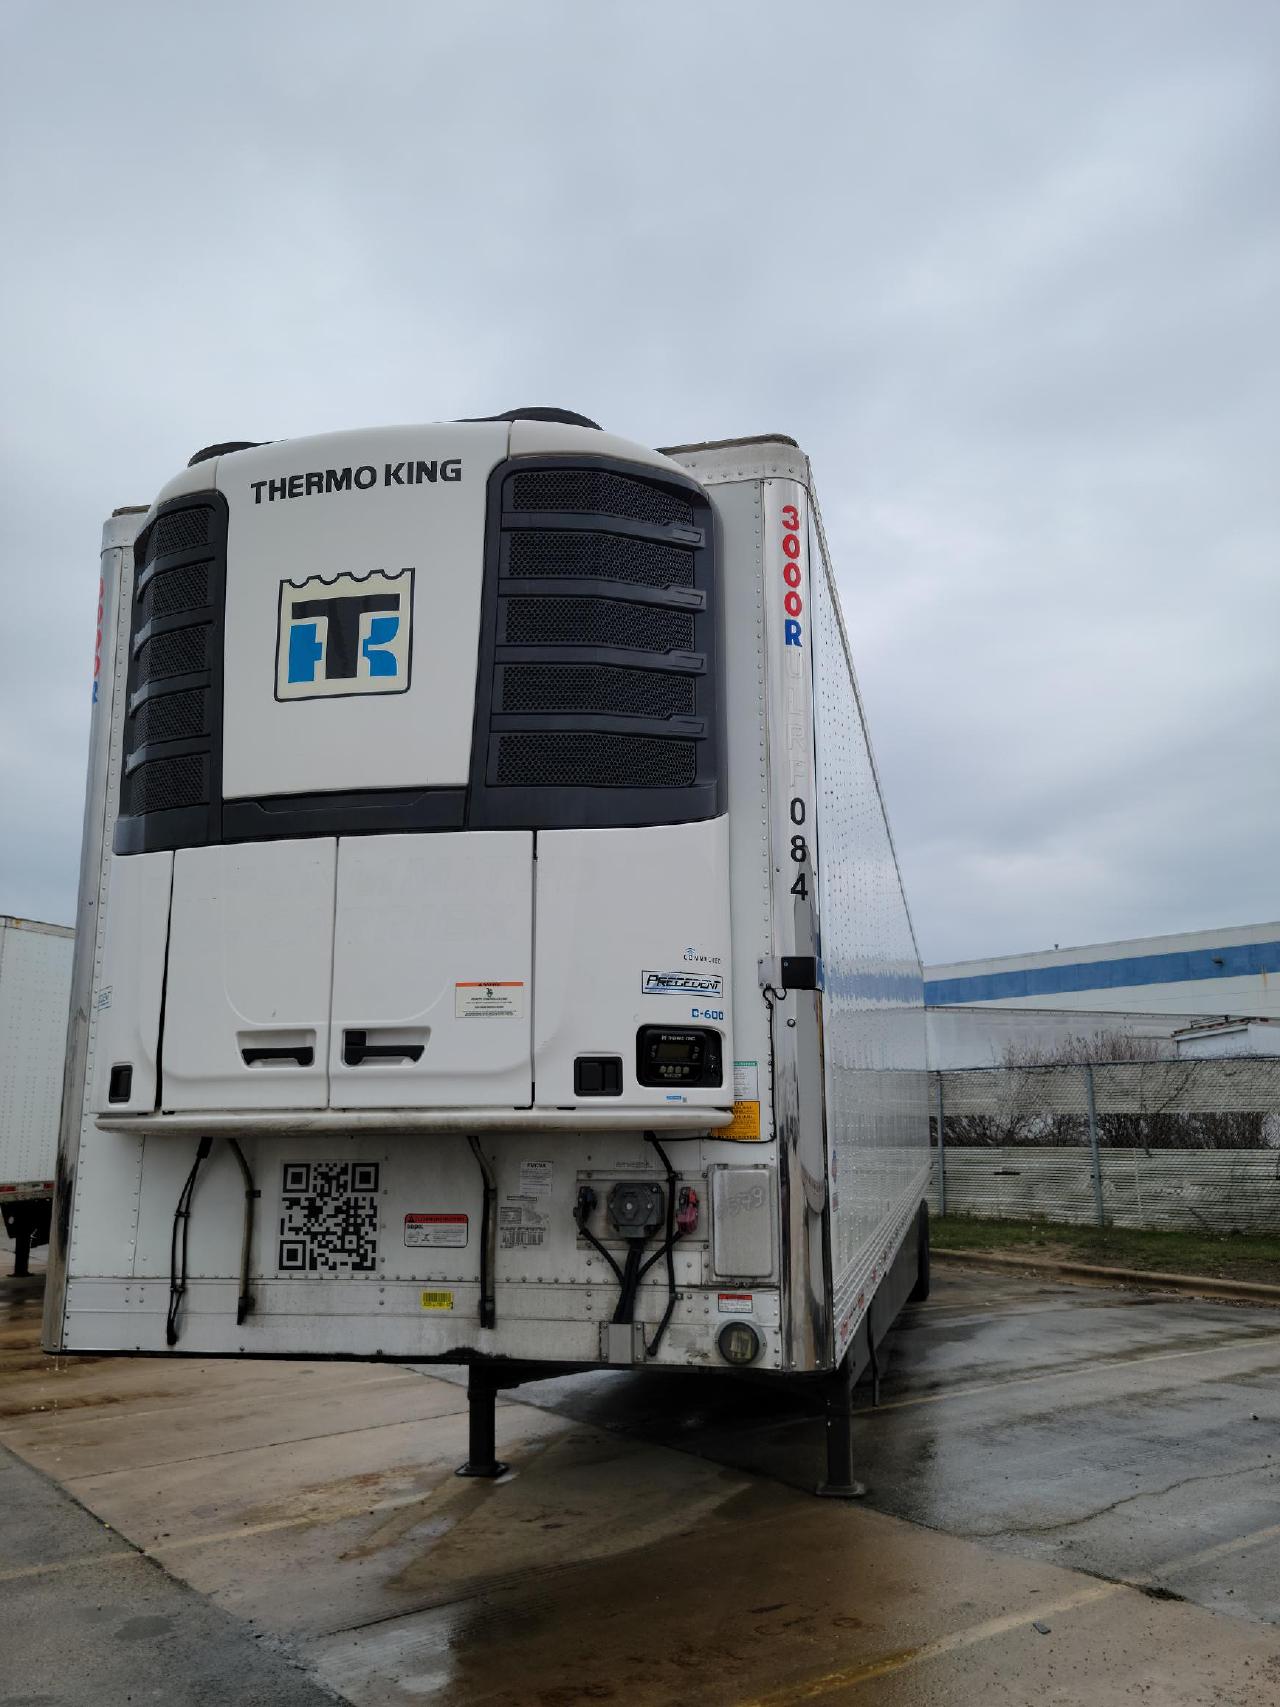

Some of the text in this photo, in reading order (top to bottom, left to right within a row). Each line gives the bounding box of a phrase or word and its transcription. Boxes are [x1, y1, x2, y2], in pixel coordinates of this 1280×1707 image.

[251, 459, 462, 504] THERMO KING
[781, 506, 803, 648] 3000R
[789, 797, 809, 901] 084
[646, 974, 721, 989] PRECEDENT
